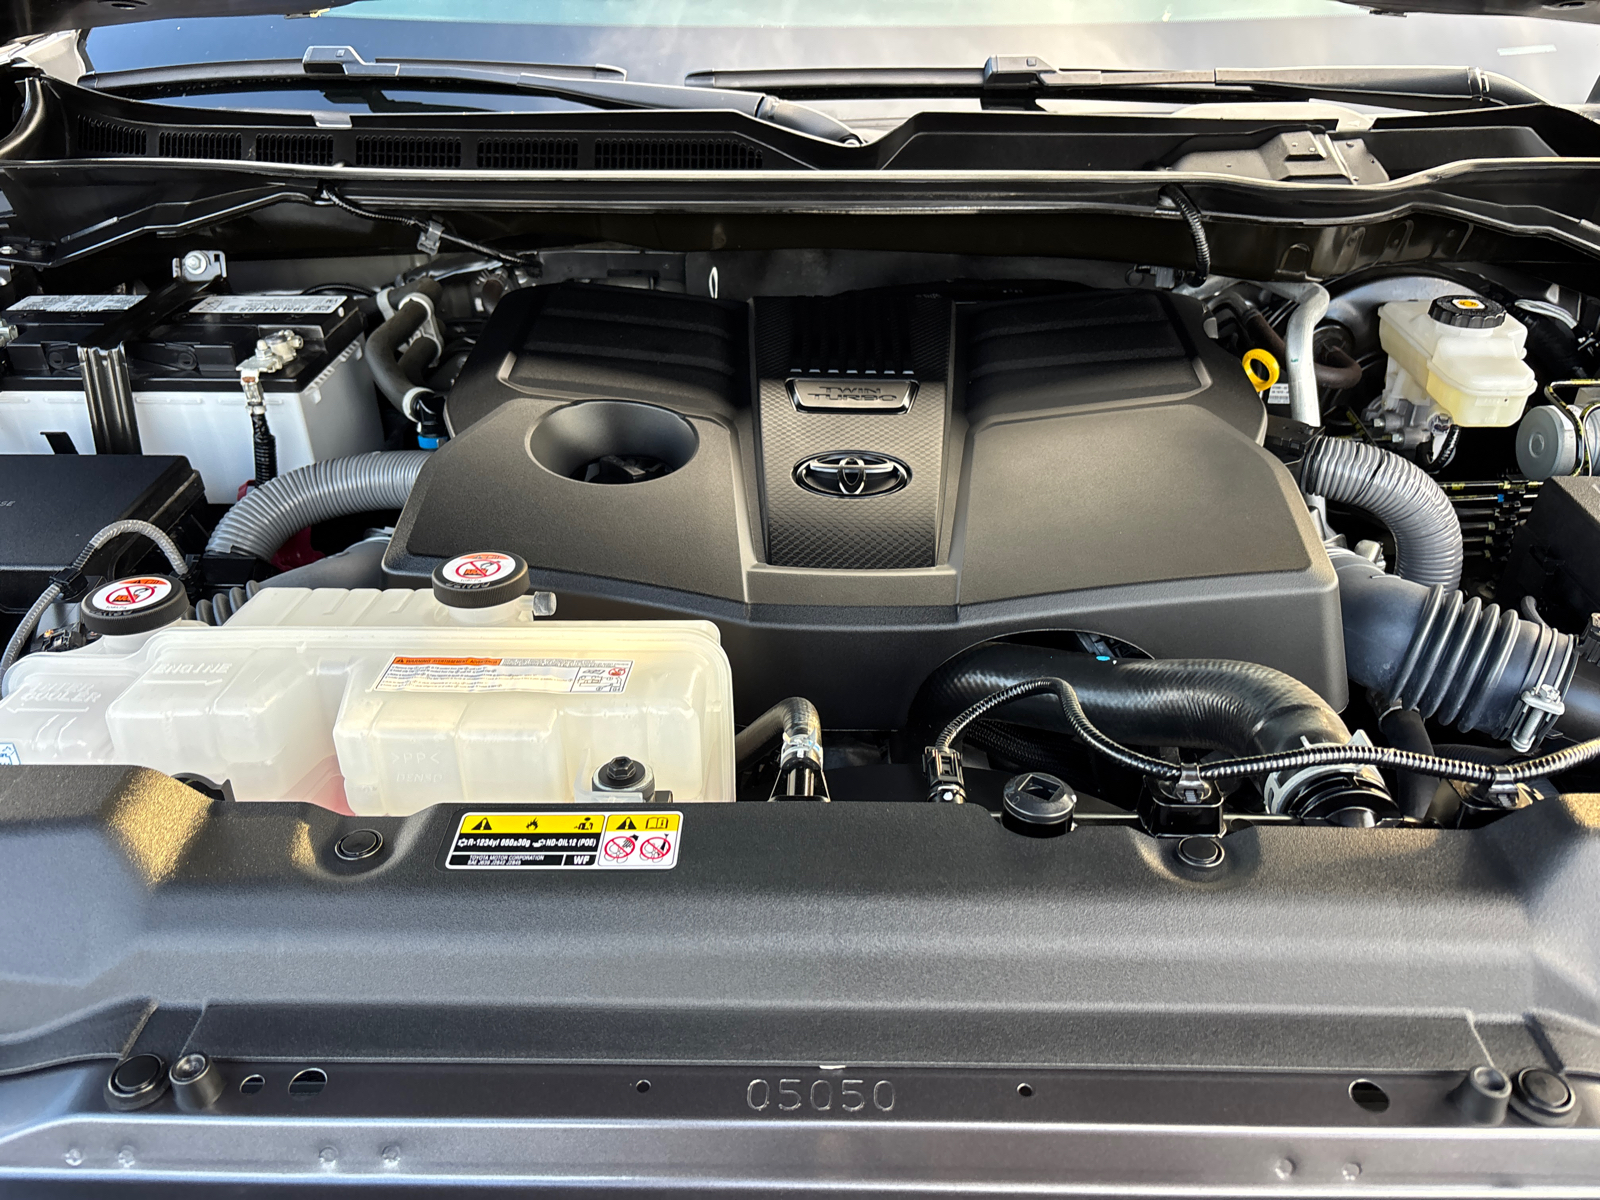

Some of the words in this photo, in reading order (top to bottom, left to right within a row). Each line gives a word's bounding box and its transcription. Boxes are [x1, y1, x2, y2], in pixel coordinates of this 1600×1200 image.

[819, 386, 881, 394] TWIN
[807, 393, 897, 402] TURBO
[153, 662, 232, 674] ENGINE
[21, 691, 102, 703] COOLER
[396, 773, 443, 783] DENSO
[468, 838, 500, 848] R-1234yf
[746, 1078, 895, 1112] 05050
